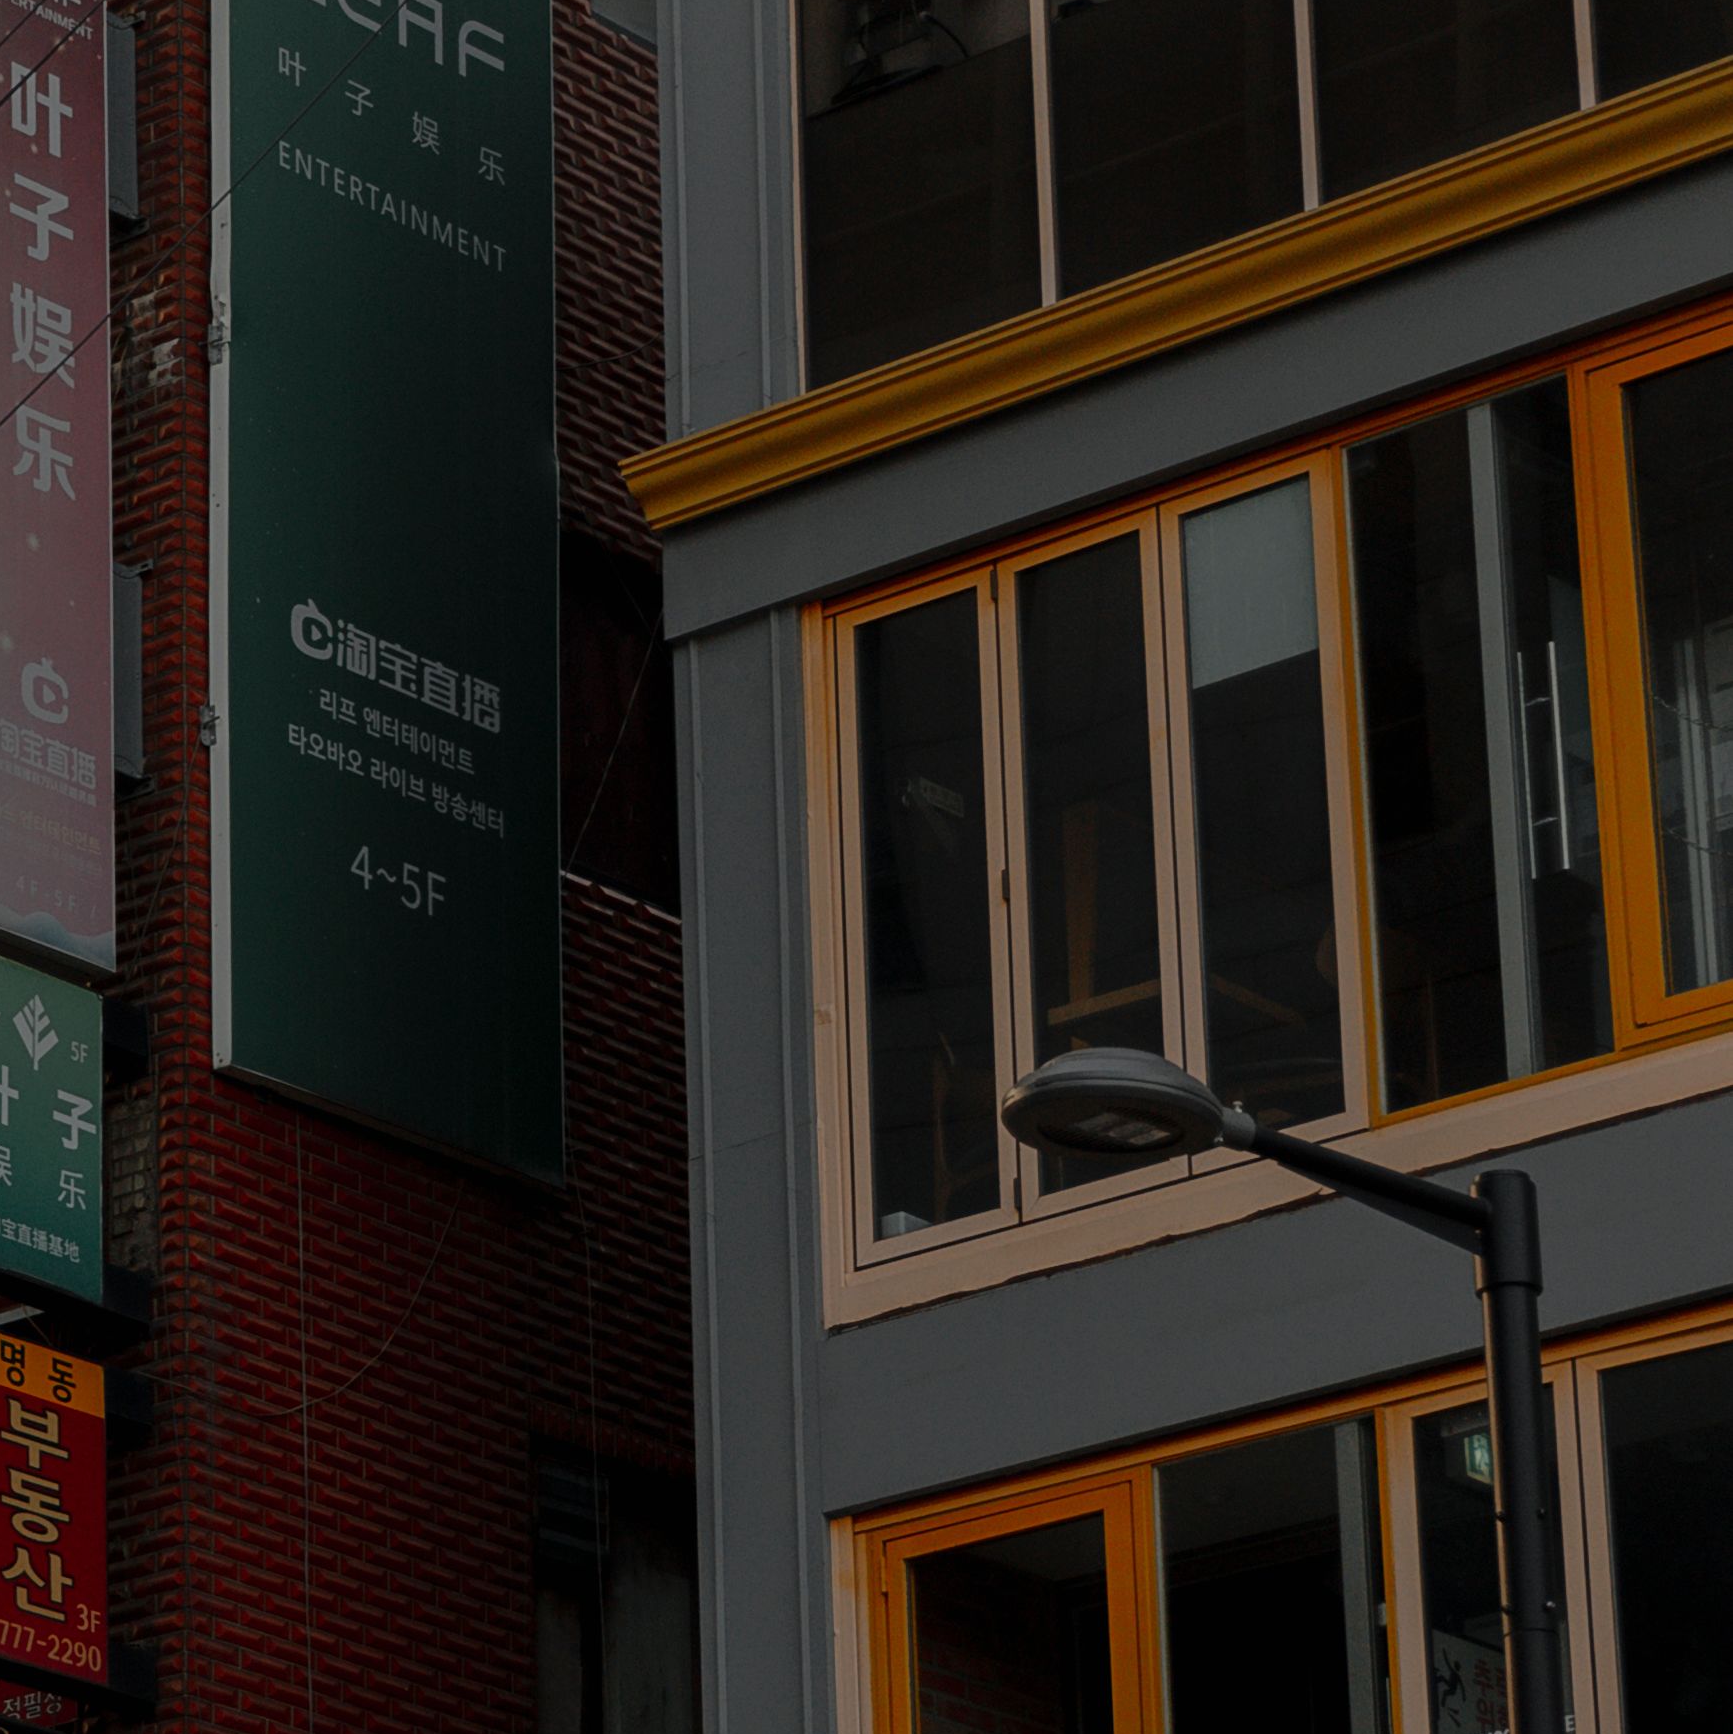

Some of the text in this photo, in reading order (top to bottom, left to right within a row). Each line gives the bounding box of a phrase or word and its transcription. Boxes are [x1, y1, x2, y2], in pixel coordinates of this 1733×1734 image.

[278, 140, 507, 270] ENTERTAINMENT
[9, 61, 77, 501] 叶子娱乐
[319, 688, 475, 775] 리프 엔터테이먼트
[336, 619, 501, 734] 淘宝直播
[288, 723, 504, 838] 타오바오 라이브 방송센터
[70, 1041, 88, 1064] 5F
[0, 1340, 76, 1403] 명동
[0, 1397, 74, 1623] 부동산
[75, 1603, 102, 1634] 3F
